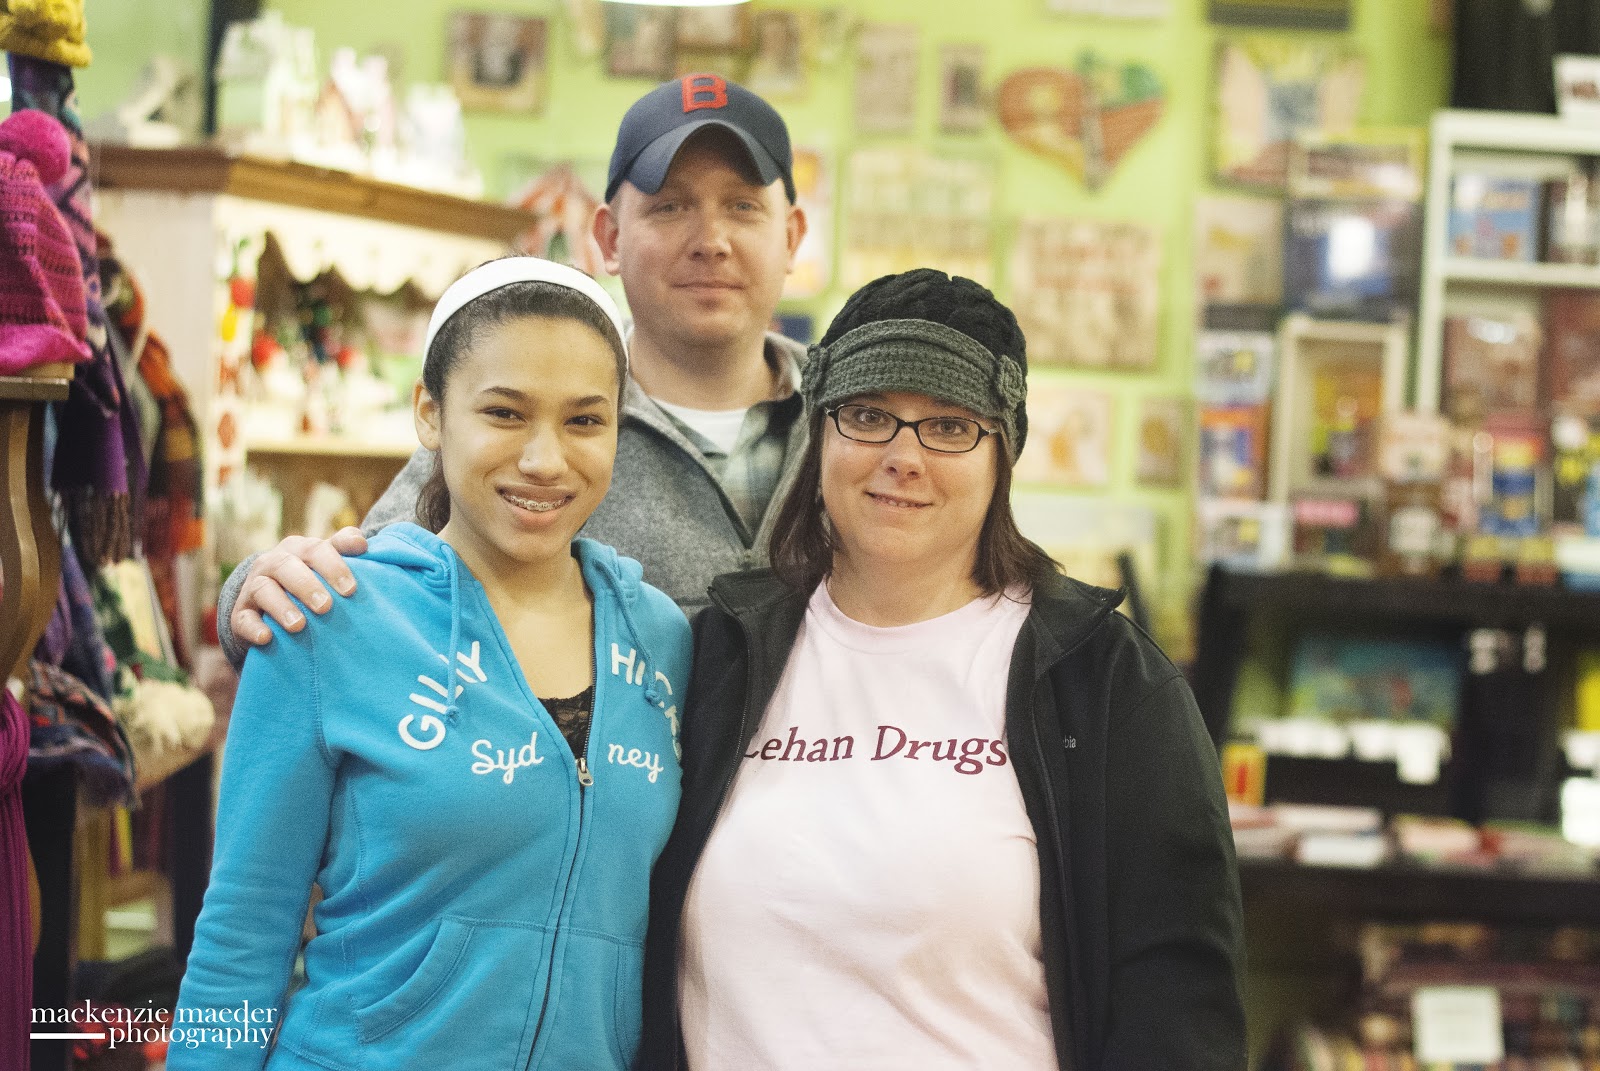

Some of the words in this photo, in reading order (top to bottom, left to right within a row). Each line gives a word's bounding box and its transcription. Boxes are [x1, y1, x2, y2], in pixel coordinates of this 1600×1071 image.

[681, 73, 728, 113] B
[471, 731, 544, 784] Syd
[607, 743, 664, 784] ney
[870, 725, 1008, 776] Drugs
